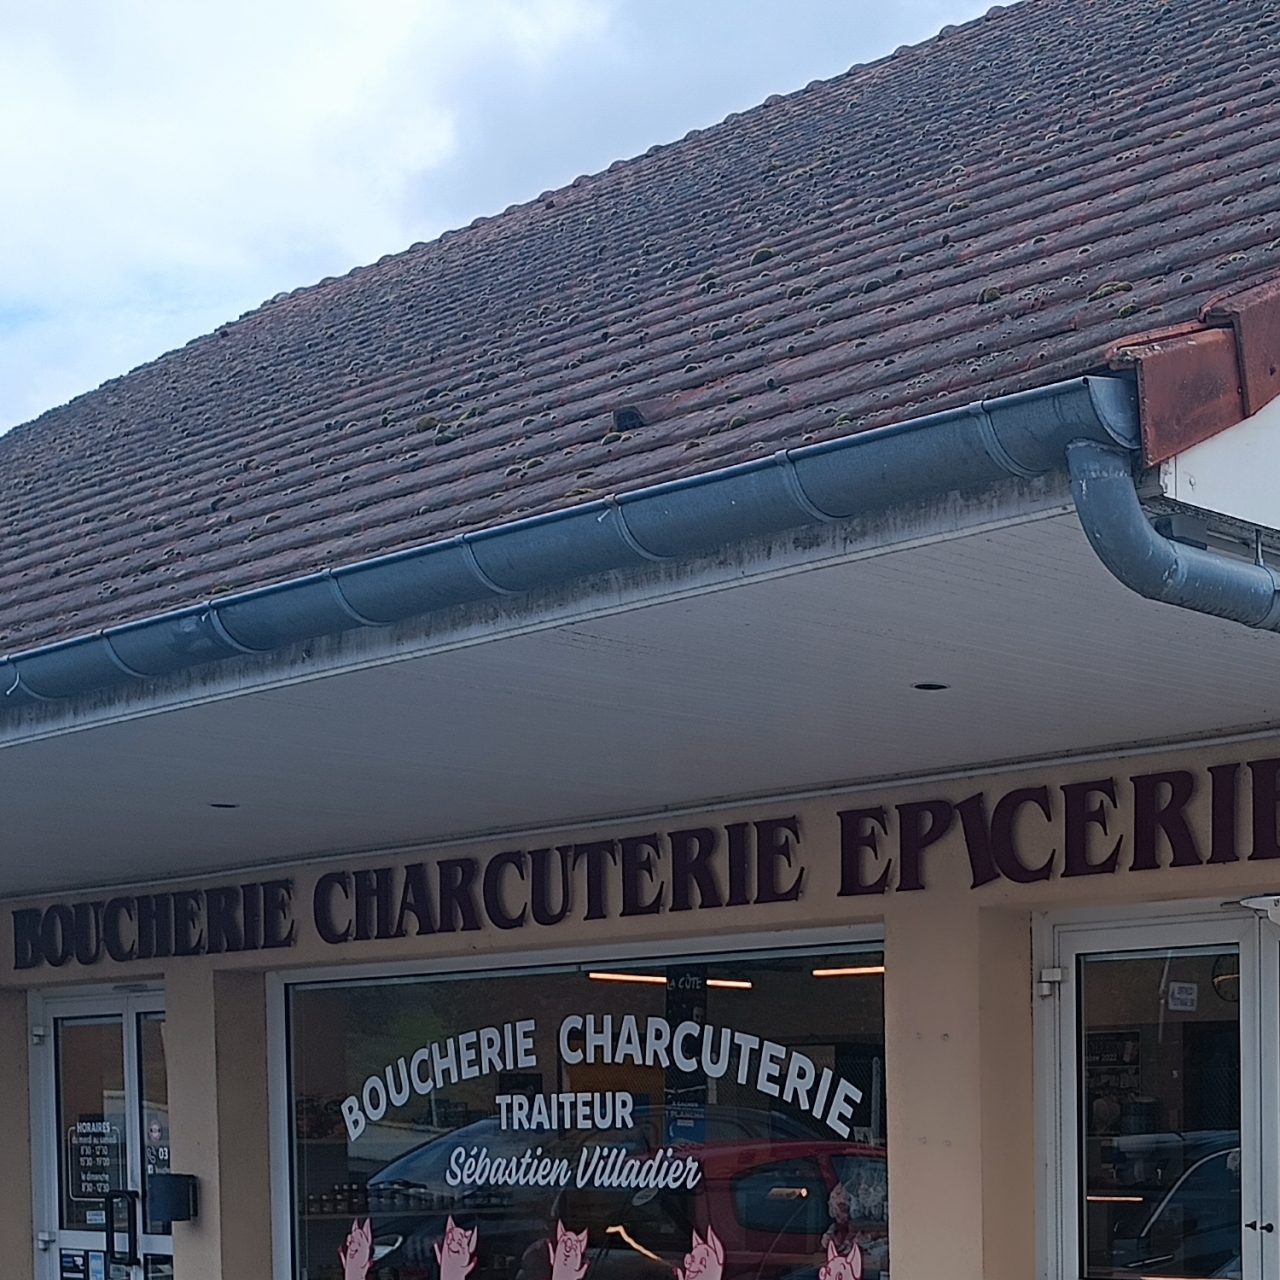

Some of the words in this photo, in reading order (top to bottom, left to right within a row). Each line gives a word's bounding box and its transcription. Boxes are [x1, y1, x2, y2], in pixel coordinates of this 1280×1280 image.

[12, 878, 297, 970] BOUCHERIE
[313, 815, 805, 944] CHARCUTERIE
[340, 1018, 537, 1141] BOUCHERIE
[559, 1014, 863, 1139] CHARCUTERIE
[76, 1122, 110, 1133] HORAIRES
[495, 1091, 634, 1131] TRAITEUR
[158, 1147, 169, 1160] 03
[444, 1147, 572, 1188] Sébastien
[573, 1146, 702, 1190] Villadier
